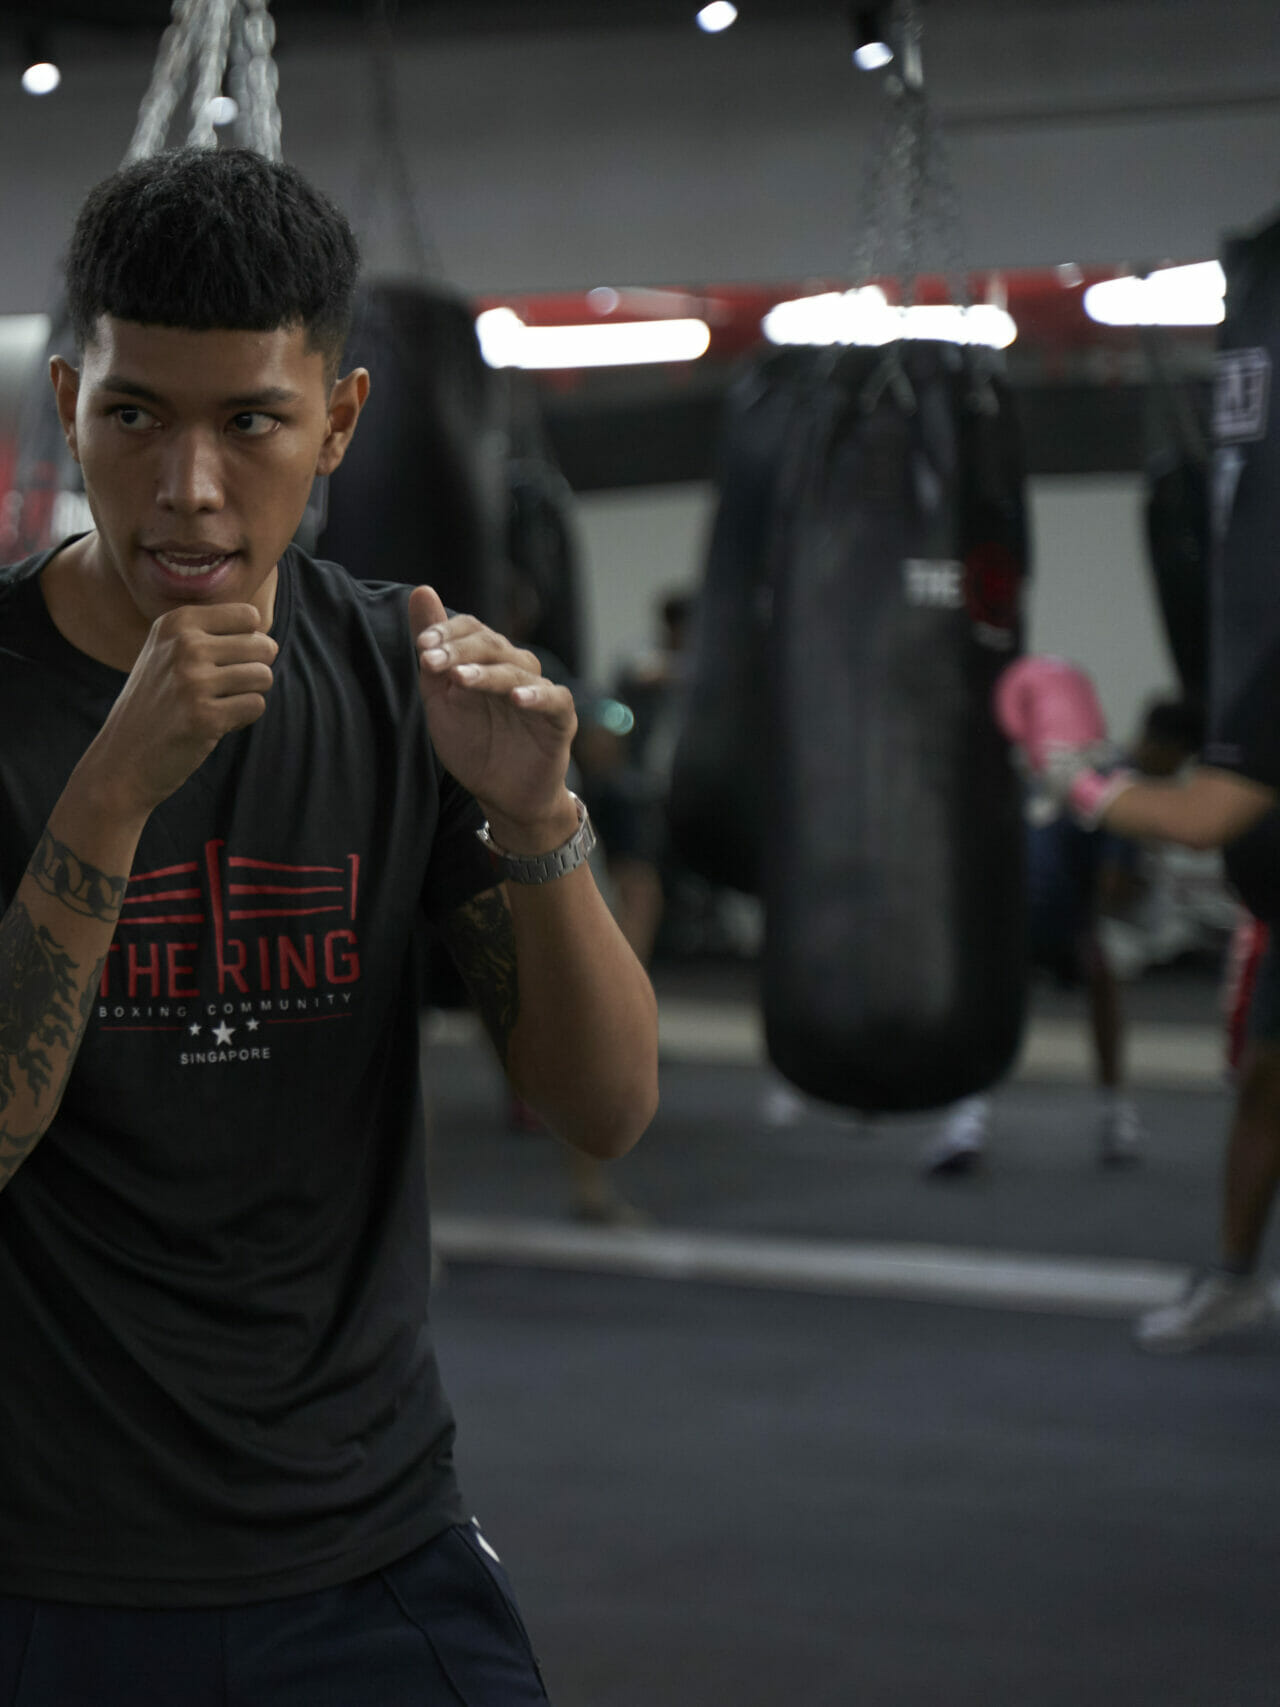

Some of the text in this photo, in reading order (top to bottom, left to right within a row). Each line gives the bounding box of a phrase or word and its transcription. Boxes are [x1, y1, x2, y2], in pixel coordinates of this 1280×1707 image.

[99, 928, 361, 998] THE RING
[98, 991, 352, 1019] BOXING COMMUNITY
[179, 1047, 271, 1065] SINGAPORE
